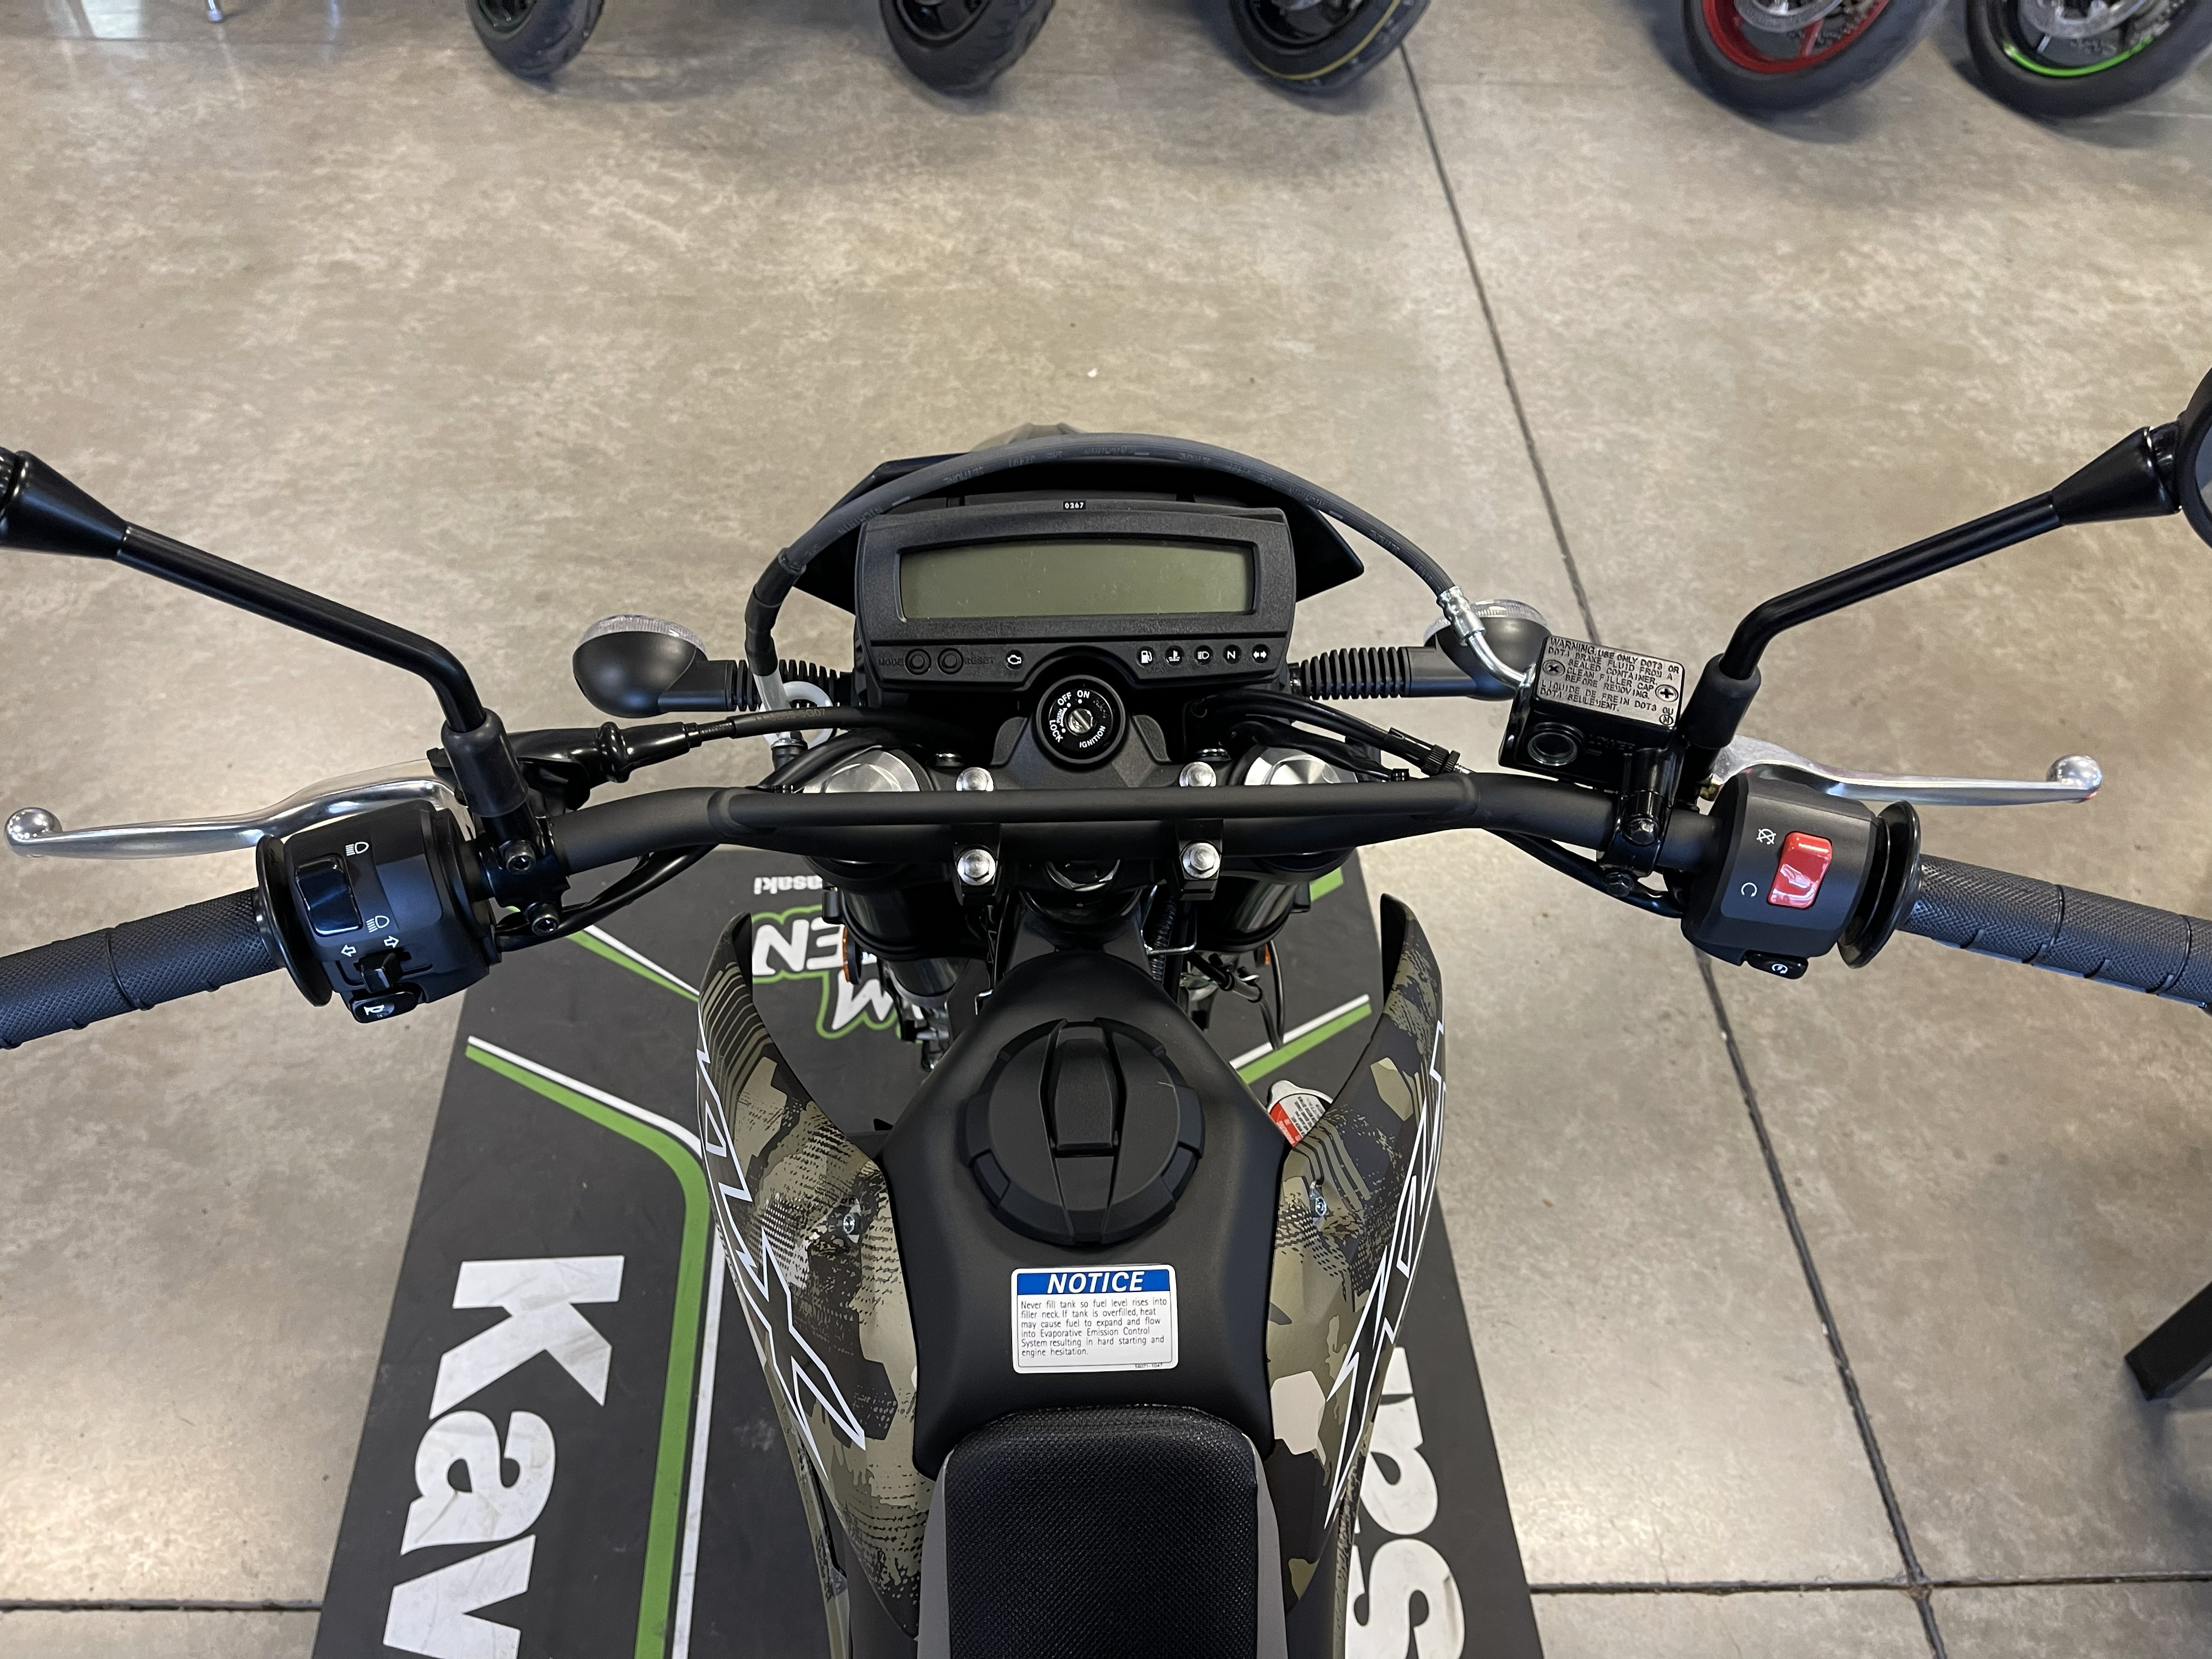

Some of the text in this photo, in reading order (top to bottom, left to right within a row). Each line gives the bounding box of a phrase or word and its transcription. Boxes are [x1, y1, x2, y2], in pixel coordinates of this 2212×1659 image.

[1226, 650, 1235, 659] N
[1598, 649, 1615, 659] USE
[1616, 653, 1638, 665] ONLY
[1640, 659, 1663, 670] DOT3
[1668, 665, 1679, 674] OR
[1568, 658, 1658, 686] SEALED CONTAINER.
[1575, 652, 1602, 665] BRAKE
[1607, 659, 1635, 672] FLUID
[1639, 667, 1662, 678] FROM
[1666, 673, 1673, 681] A
[1565, 674, 1599, 688] BEFORE
[1567, 667, 1655, 692] CLEAN FILLER CAP
[1057, 691, 1072, 706] OFF
[1077, 690, 1090, 699] ON
[1585, 689, 1597, 699] DE
[1602, 692, 1630, 706] FREIN
[1634, 700, 1657, 712] DOT3
[1662, 706, 1674, 715] OU
[1049, 719, 1063, 743] LOCK
[1079, 725, 1106, 748] IGNITION
[752, 916, 877, 975] EN
[1047, 1271, 1145, 1294] NOTICE
[1021, 1300, 1042, 1309] Never
[1046, 1300, 1056, 1308] fill
[1060, 1300, 1076, 1308] tank
[1093, 1299, 1107, 1307] fuel
[1111, 1298, 1128, 1307] level
[1132, 1297, 1148, 1306] rises
[1153, 1297, 1167, 1306] into
[1021, 1310, 1037, 1318] filler
[1062, 1309, 1068, 1318] If
[1072, 1309, 1088, 1318] tank
[1092, 1308, 1098, 1317] is
[1102, 1307, 1138, 1317] overfilled,
[1140, 1307, 1156, 1316] heat
[1021, 1321, 1036, 1330] may
[1066, 1318, 1080, 1327] fuel
[1084, 1319, 1092, 1327] to
[1096, 1317, 1122, 1328] expand
[1127, 1317, 1140, 1325] and
[1145, 1316, 1160, 1325] flow
[1021, 1326, 1150, 1339] into Evaporative Emission Control
[1021, 1335, 1164, 1348] System resulting in hard starting and
[1022, 1347, 1088, 1358] engine hesitation.
